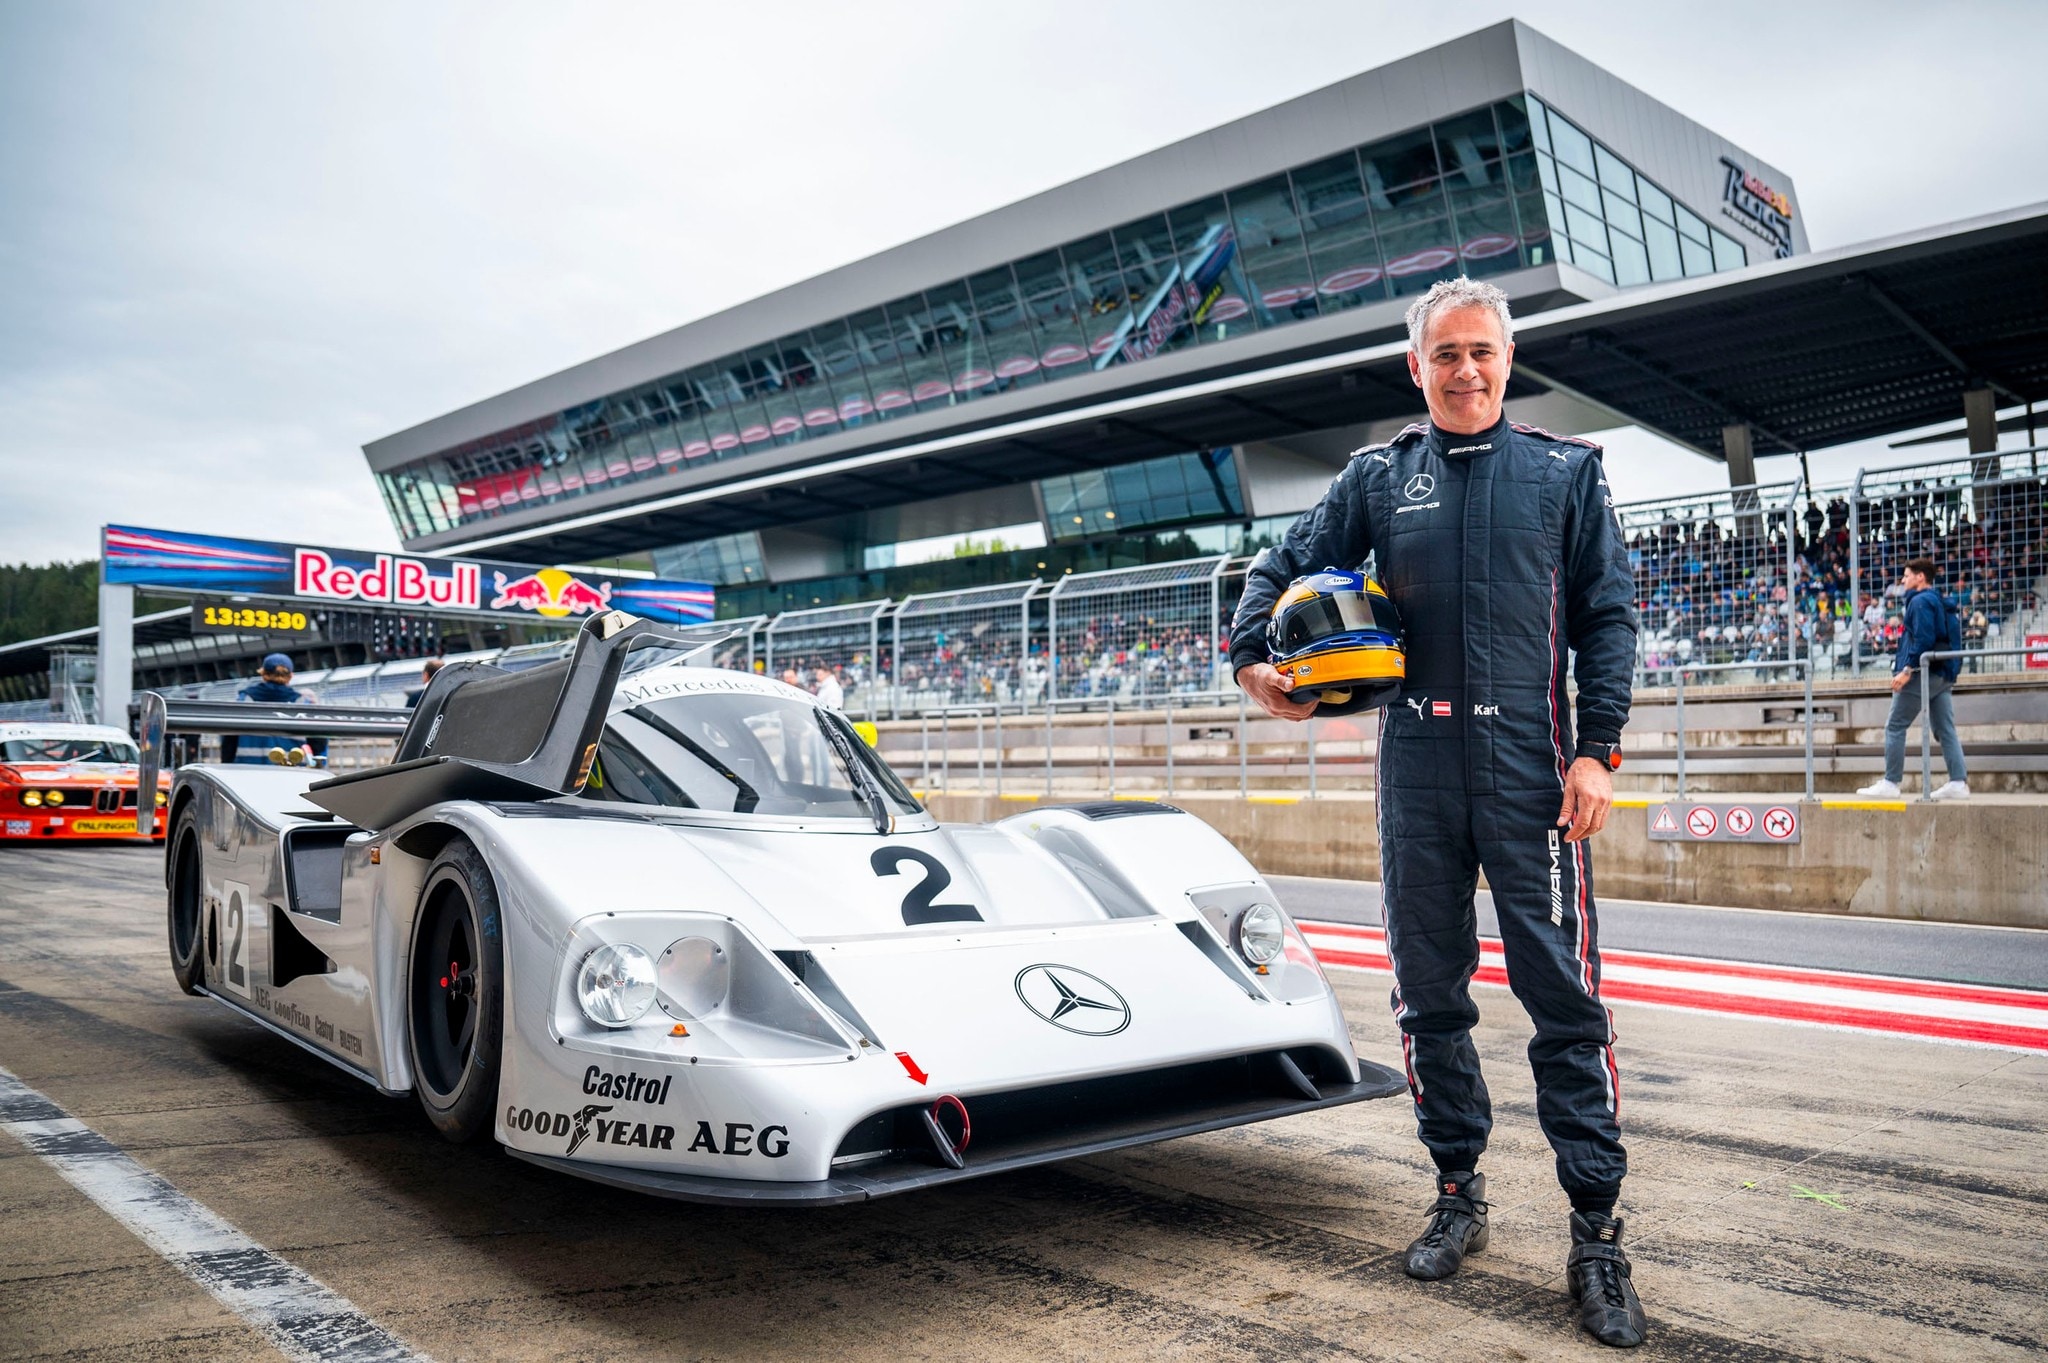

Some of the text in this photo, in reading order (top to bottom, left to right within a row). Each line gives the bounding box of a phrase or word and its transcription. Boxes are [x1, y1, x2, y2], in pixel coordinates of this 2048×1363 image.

[1463, 443, 1493, 453] AMG
[1410, 501, 1440, 512] AMG
[294, 547, 482, 609] Red Bull
[204, 606, 307, 631] 13:33:30
[1474, 704, 1499, 716] Karl
[1548, 830, 1562, 894] AMG
[870, 846, 984, 925] 2
[228, 889, 245, 988] 2
[255, 986, 271, 1010] AEG
[315, 1014, 334, 1042] Castrol
[340, 1029, 363, 1057] BILSTEIN
[582, 1064, 672, 1105] Castrol
[688, 1121, 790, 1158] AEG
